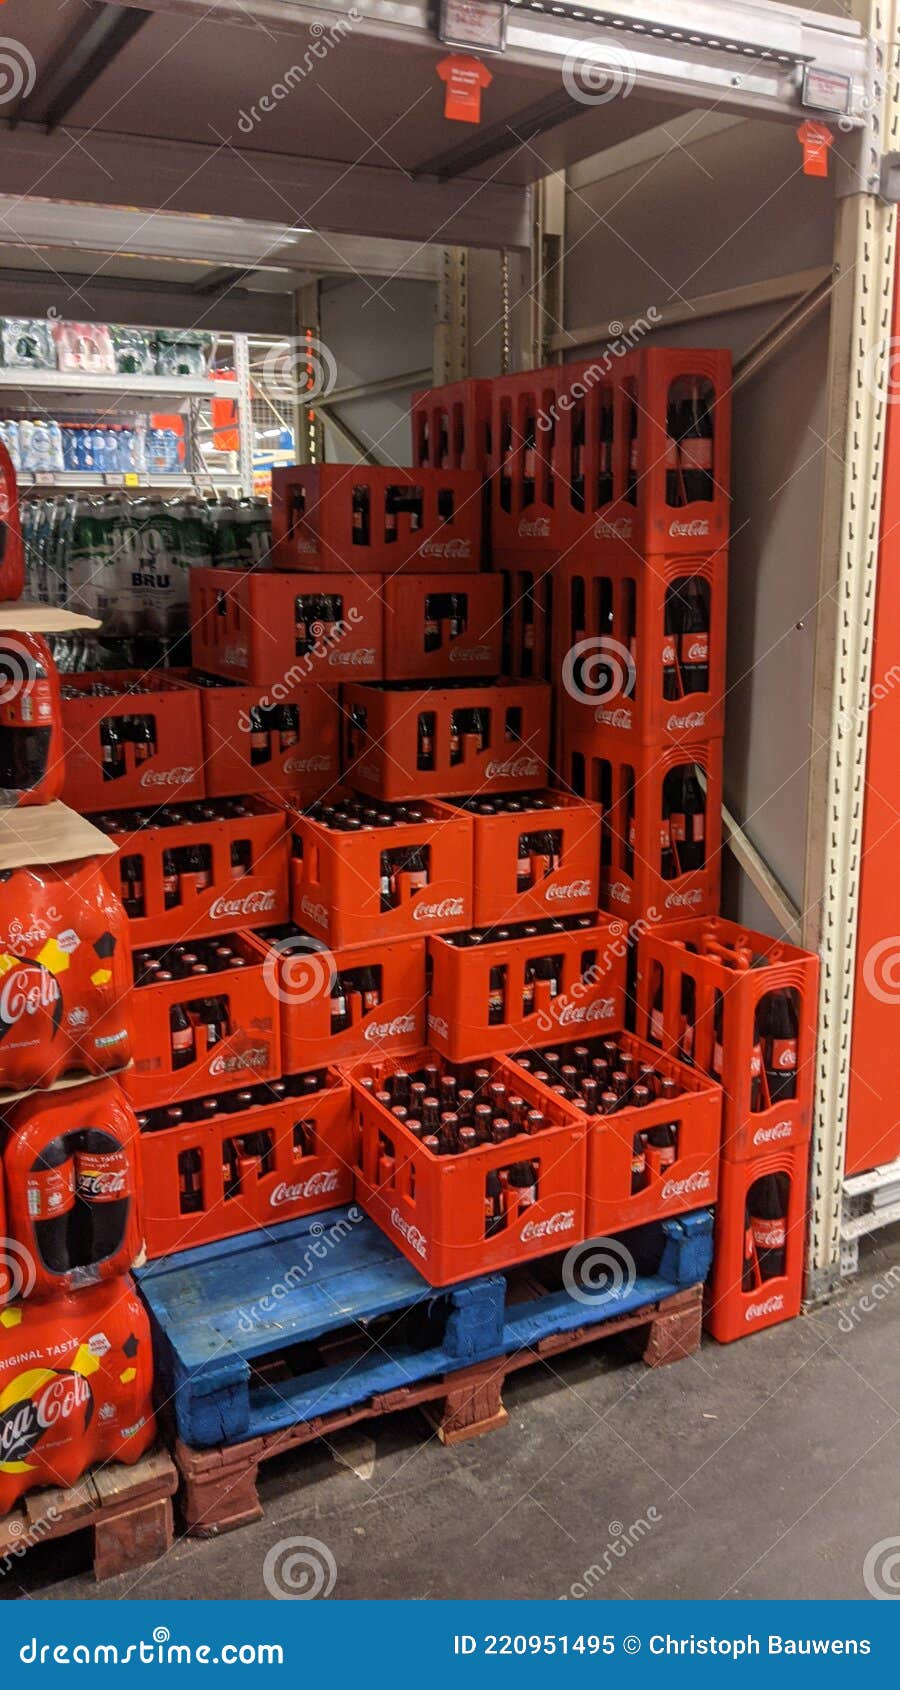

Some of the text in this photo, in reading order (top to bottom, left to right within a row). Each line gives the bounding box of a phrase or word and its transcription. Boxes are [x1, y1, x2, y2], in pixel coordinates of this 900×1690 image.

[131, 572, 170, 587] BRU
[46, 1337, 80, 1357] TASTE
[0, 1371, 91, 1450] ca-Cola
